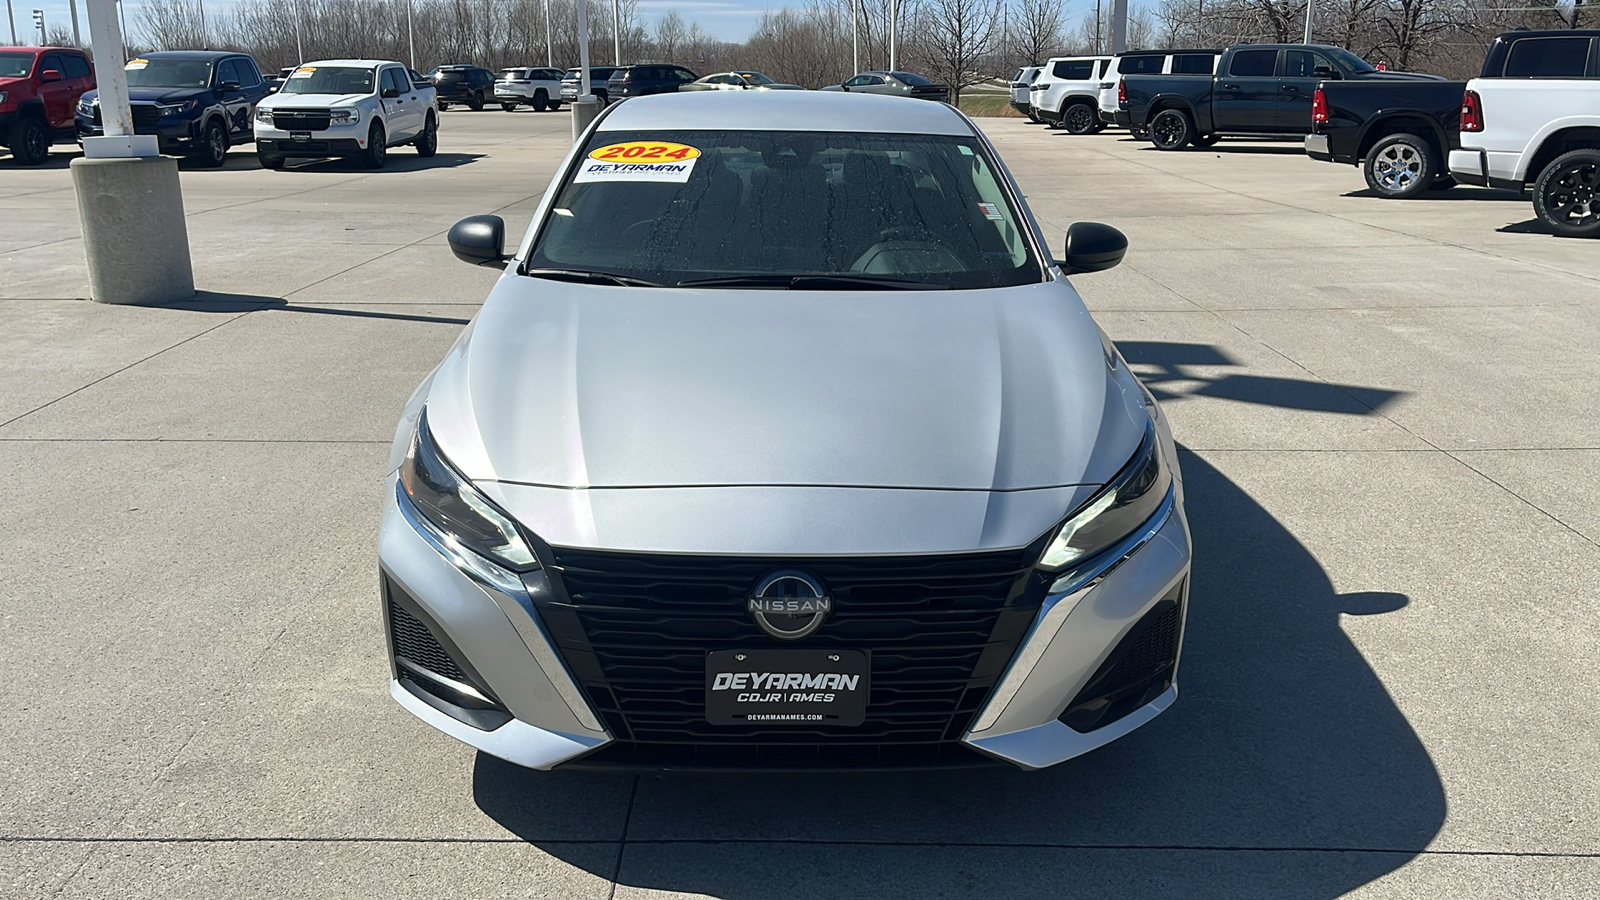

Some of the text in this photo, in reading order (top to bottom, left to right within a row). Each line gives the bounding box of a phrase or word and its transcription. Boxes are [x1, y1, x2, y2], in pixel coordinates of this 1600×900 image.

[598, 146, 691, 159] 2024
[587, 163, 687, 172] DEYARMAN
[750, 599, 829, 611] NISSAN
[712, 673, 860, 691] DEYARMAN
[789, 693, 836, 703] AMES
